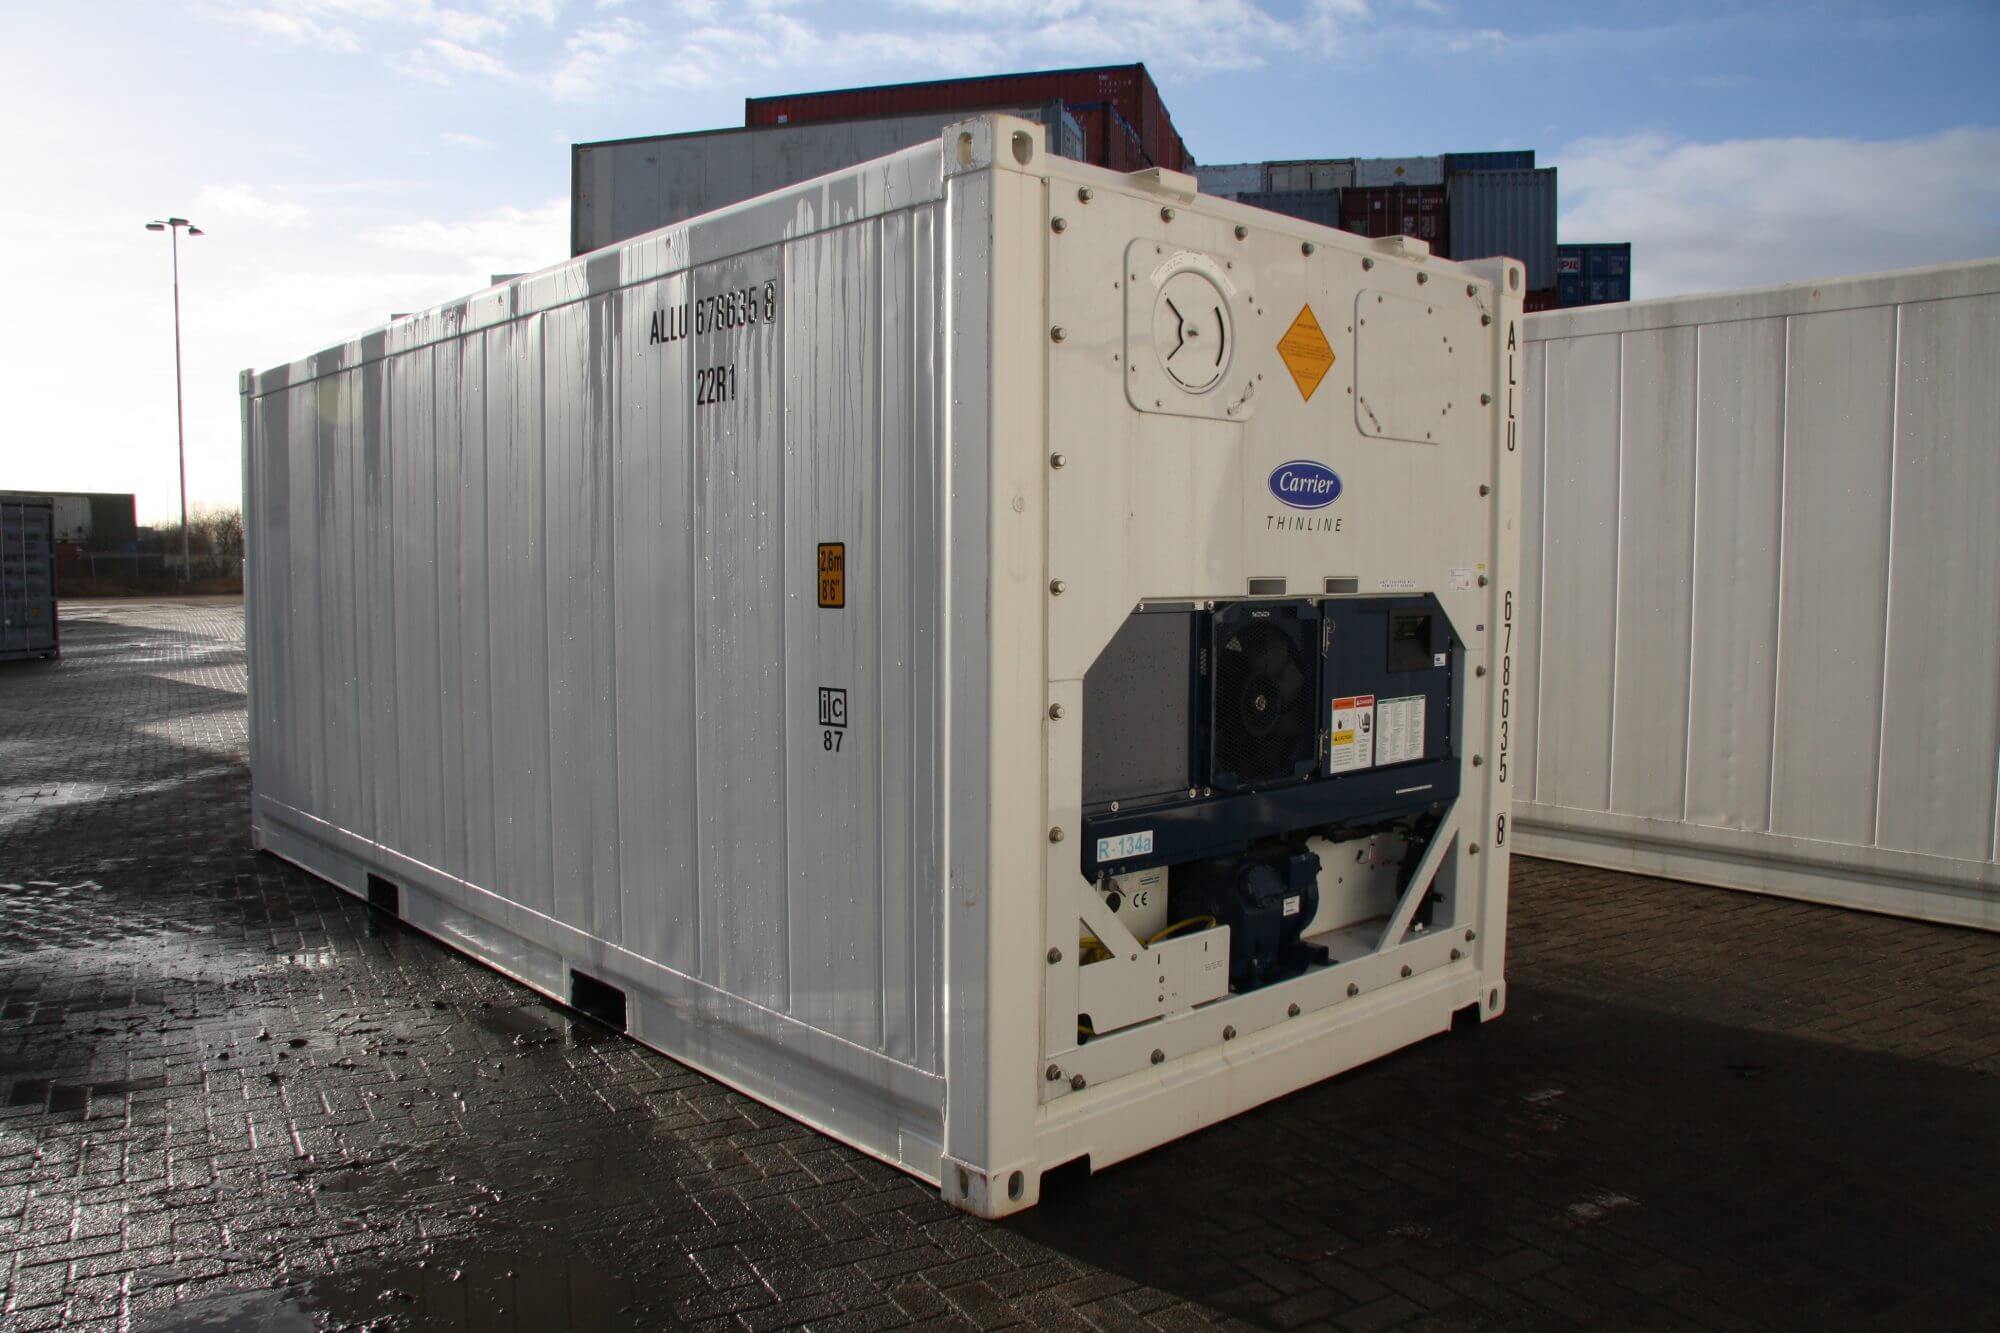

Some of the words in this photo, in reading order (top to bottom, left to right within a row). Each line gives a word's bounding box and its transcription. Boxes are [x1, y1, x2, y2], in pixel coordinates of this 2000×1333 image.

[650, 304, 688, 345] ALLU
[696, 286, 757, 335] 678635
[765, 282, 775, 321] 8
[697, 363, 735, 405] 22R1
[1507, 320, 1516, 451] ALLU
[1280, 471, 1333, 493] Carrier
[1267, 515, 1342, 532] THINLINE
[1500, 590, 1512, 783] 678635
[824, 730, 843, 753] 87
[1497, 815, 1505, 845] 8
[1133, 892, 1147, 908] CE
